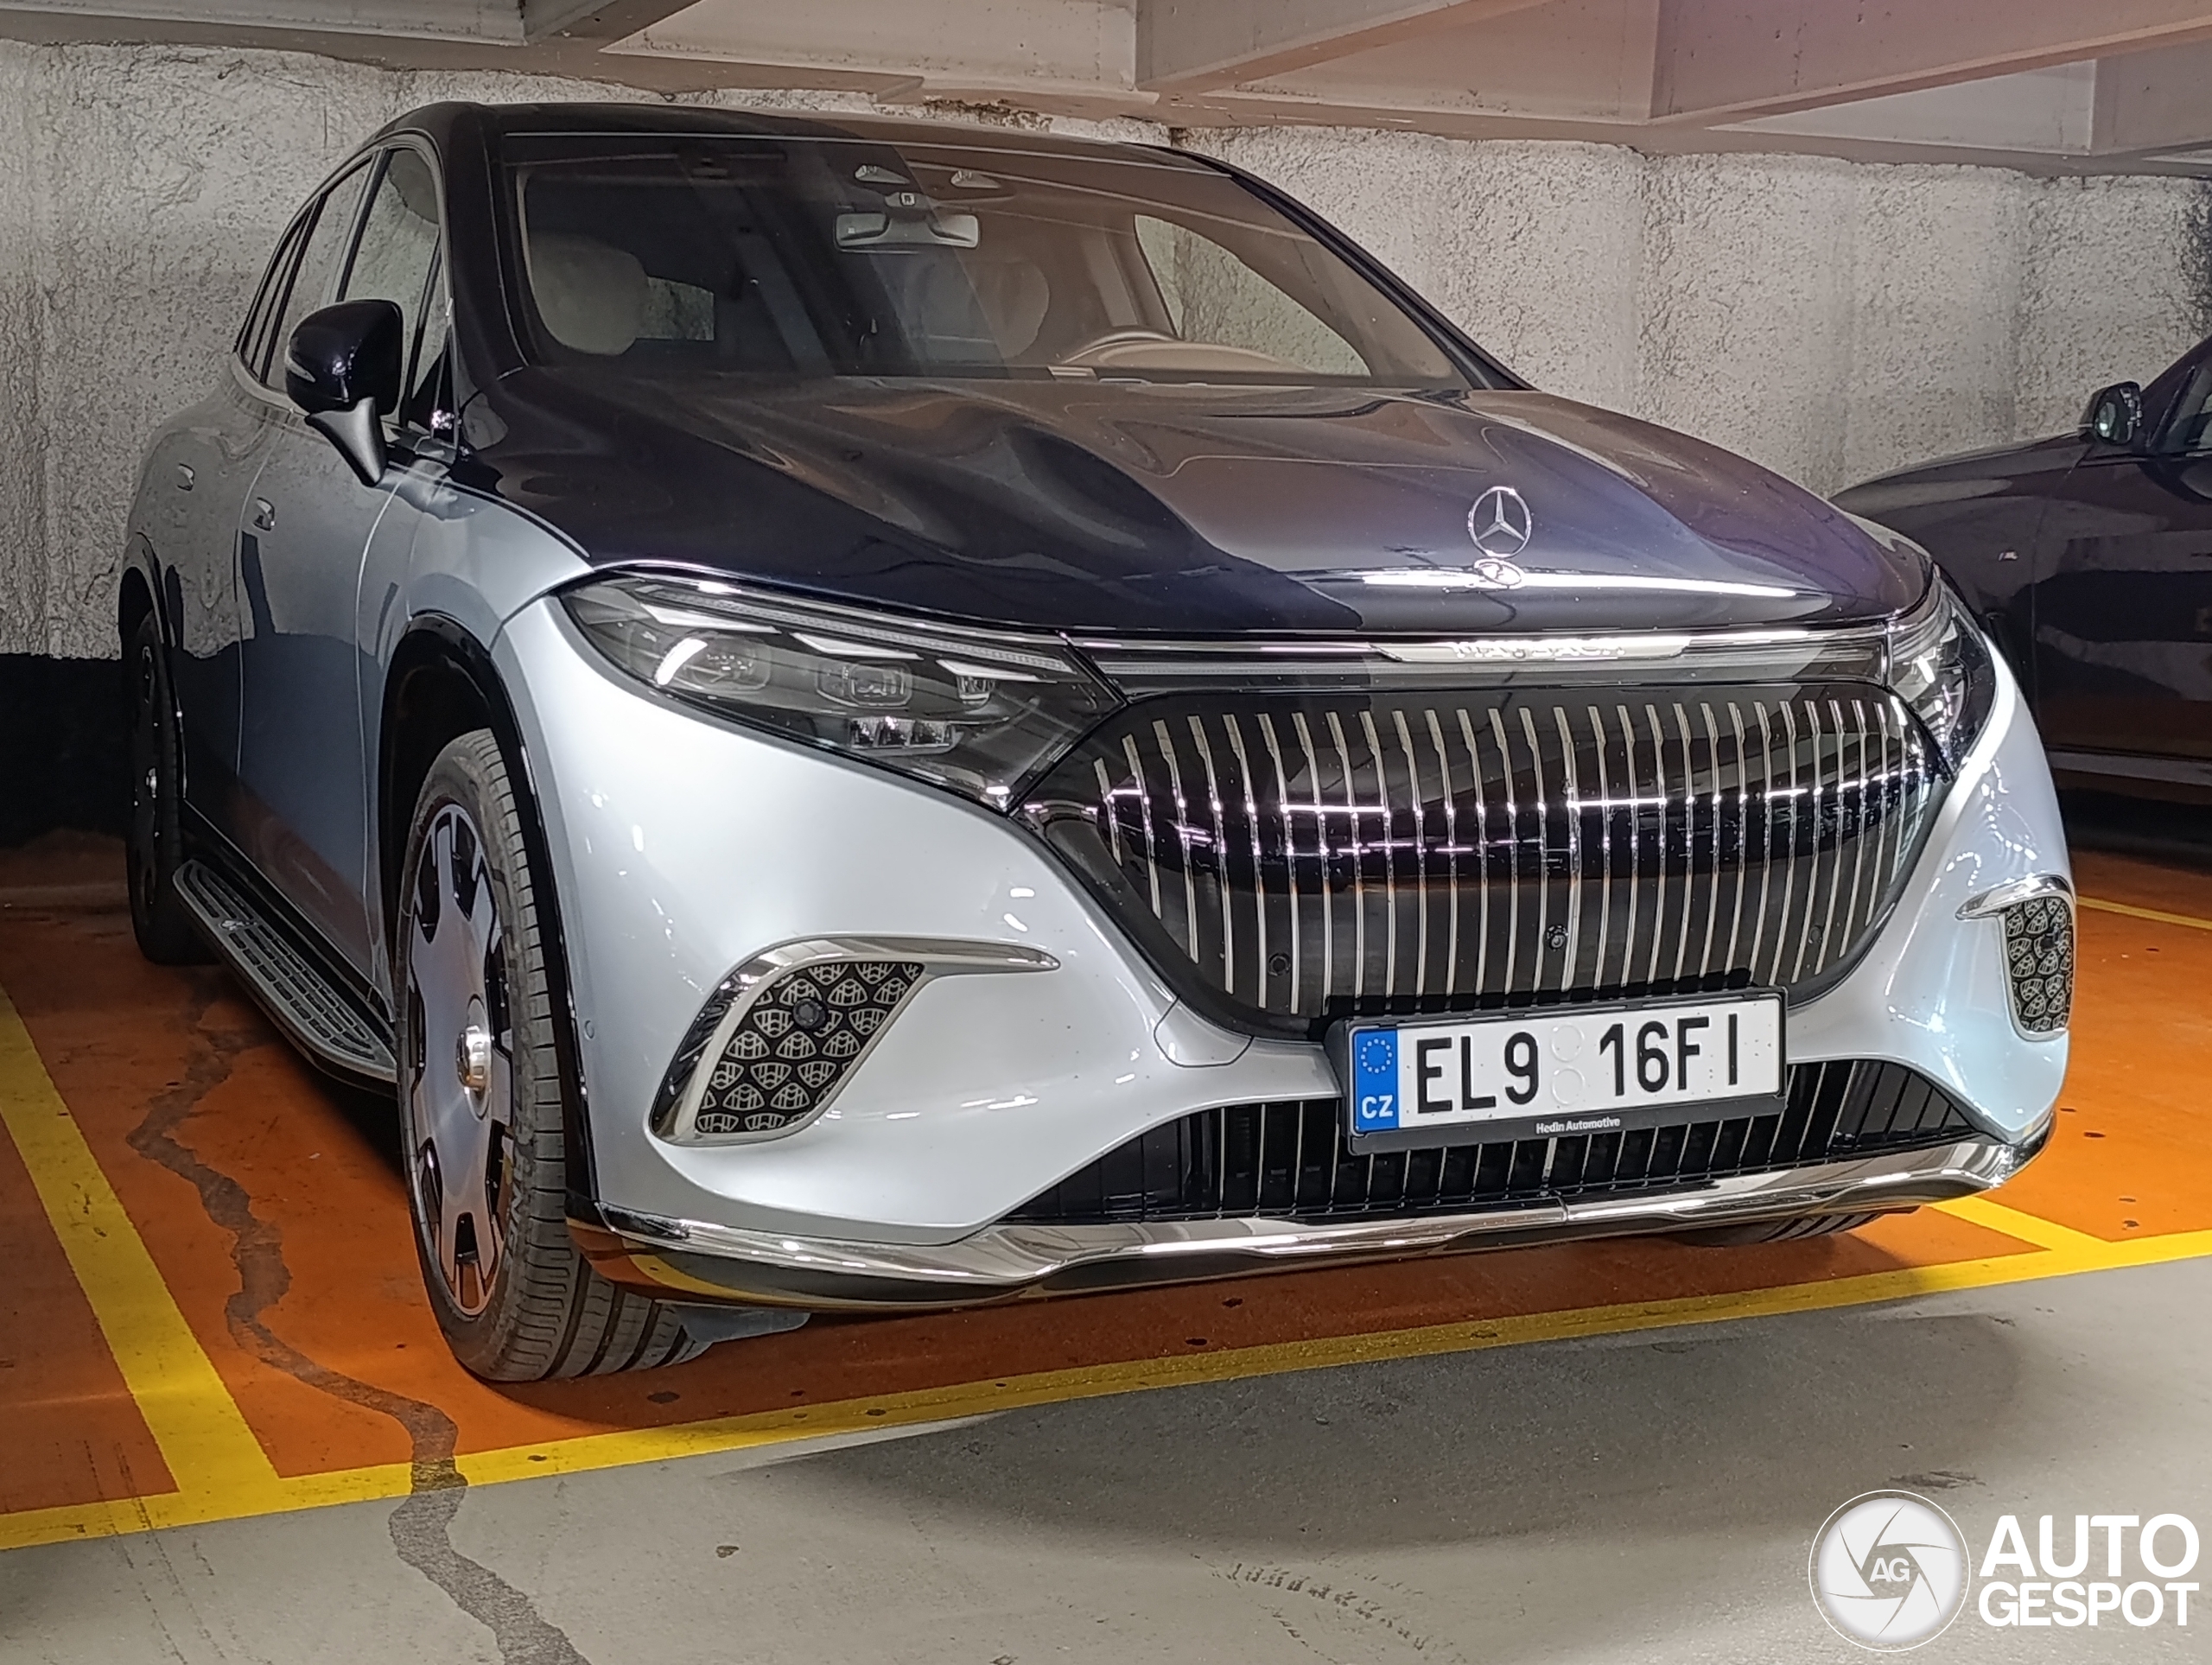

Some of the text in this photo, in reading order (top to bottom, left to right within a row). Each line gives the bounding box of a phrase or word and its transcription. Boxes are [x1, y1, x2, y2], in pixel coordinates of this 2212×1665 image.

[1416, 1032, 1540, 1114] EL9
[1361, 1094, 1394, 1120] CZ
[1536, 1116, 1621, 1134] Hedin Automotive
